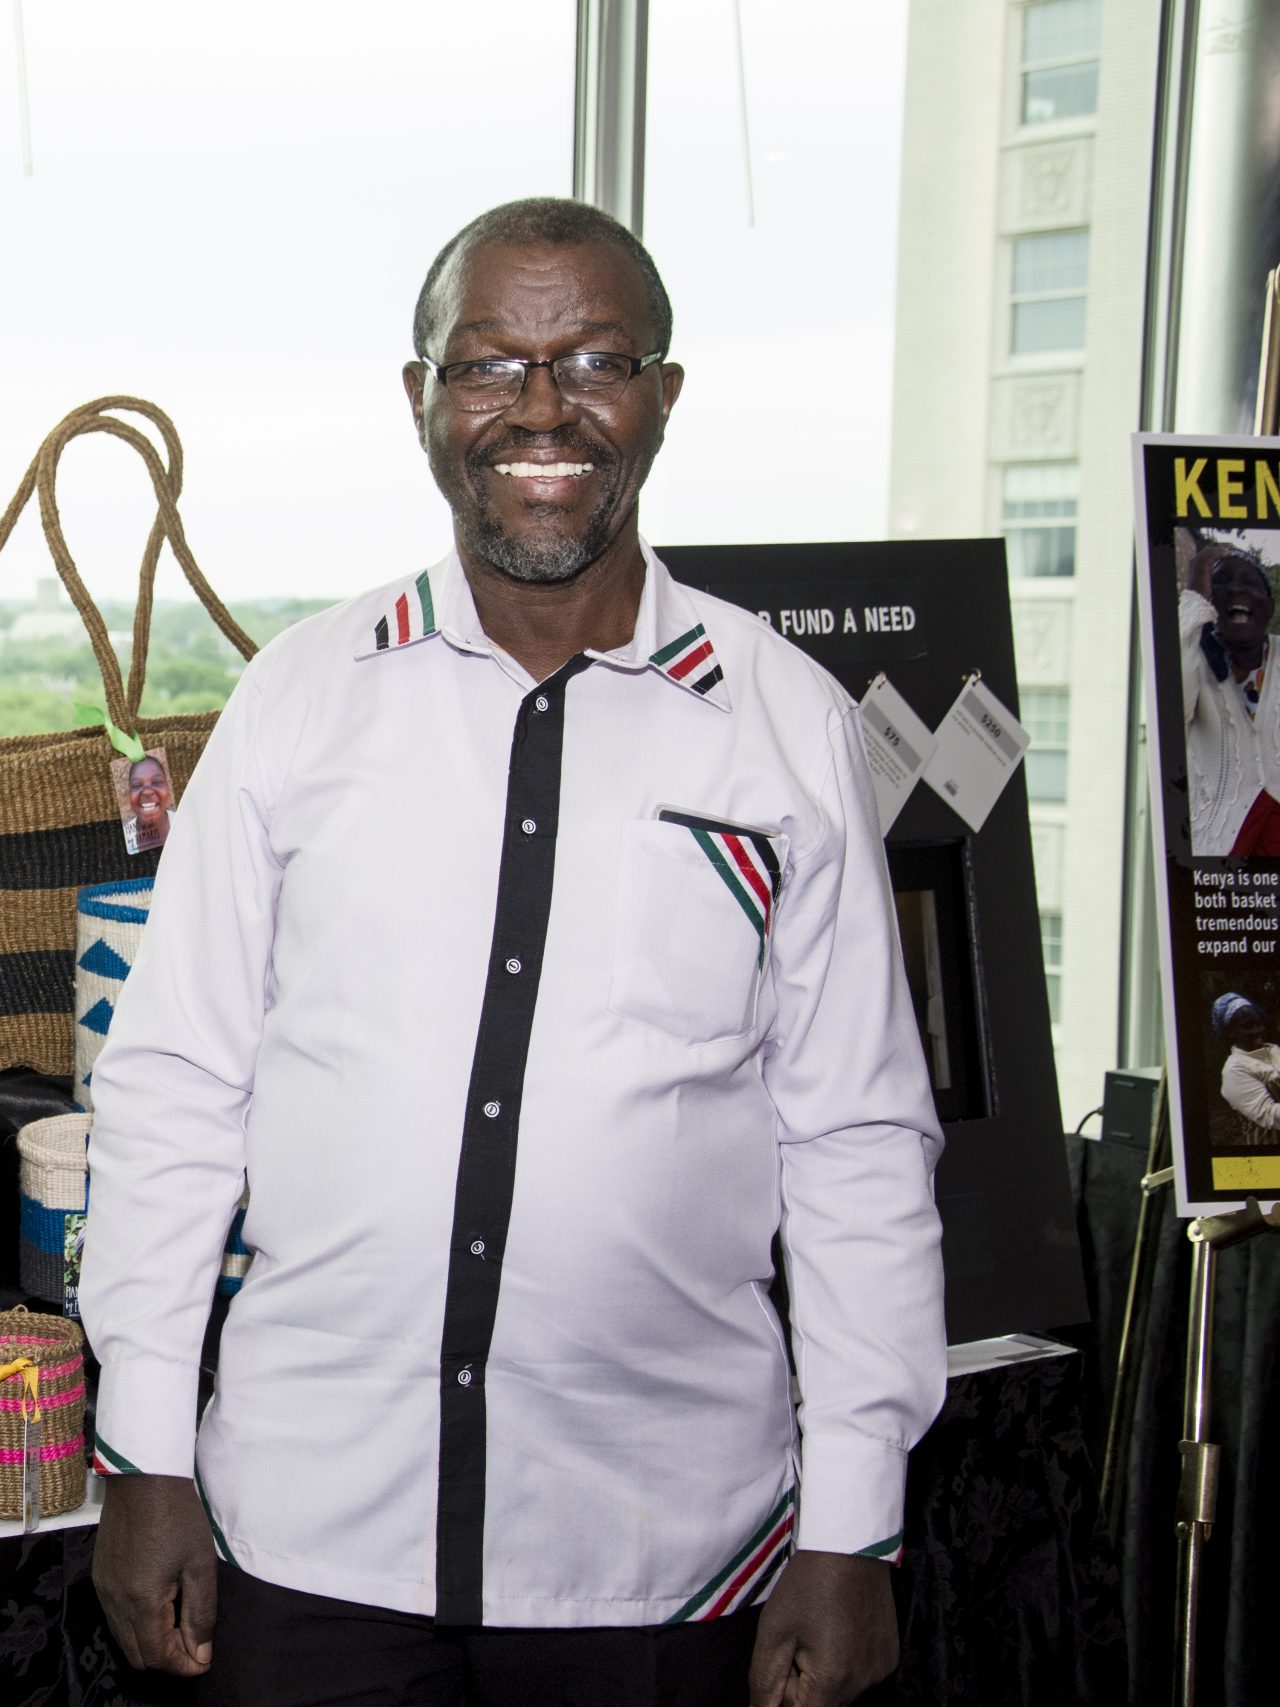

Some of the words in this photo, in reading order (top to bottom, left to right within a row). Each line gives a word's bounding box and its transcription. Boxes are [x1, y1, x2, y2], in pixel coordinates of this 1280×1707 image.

[780, 608, 835, 636] FUND
[843, 607, 858, 634] A
[864, 605, 916, 633] NEED
[883, 726, 901, 747] $75
[981, 713, 1002, 739] $250
[1193, 869, 1235, 889] Kenya
[1238, 868, 1250, 886] is
[1253, 872, 1279, 886] one
[1195, 891, 1227, 909] both
[1231, 891, 1277, 909] basket
[1195, 914, 1279, 931] tremendous
[1197, 936, 1248, 957] expand
[1252, 940, 1277, 953] our
